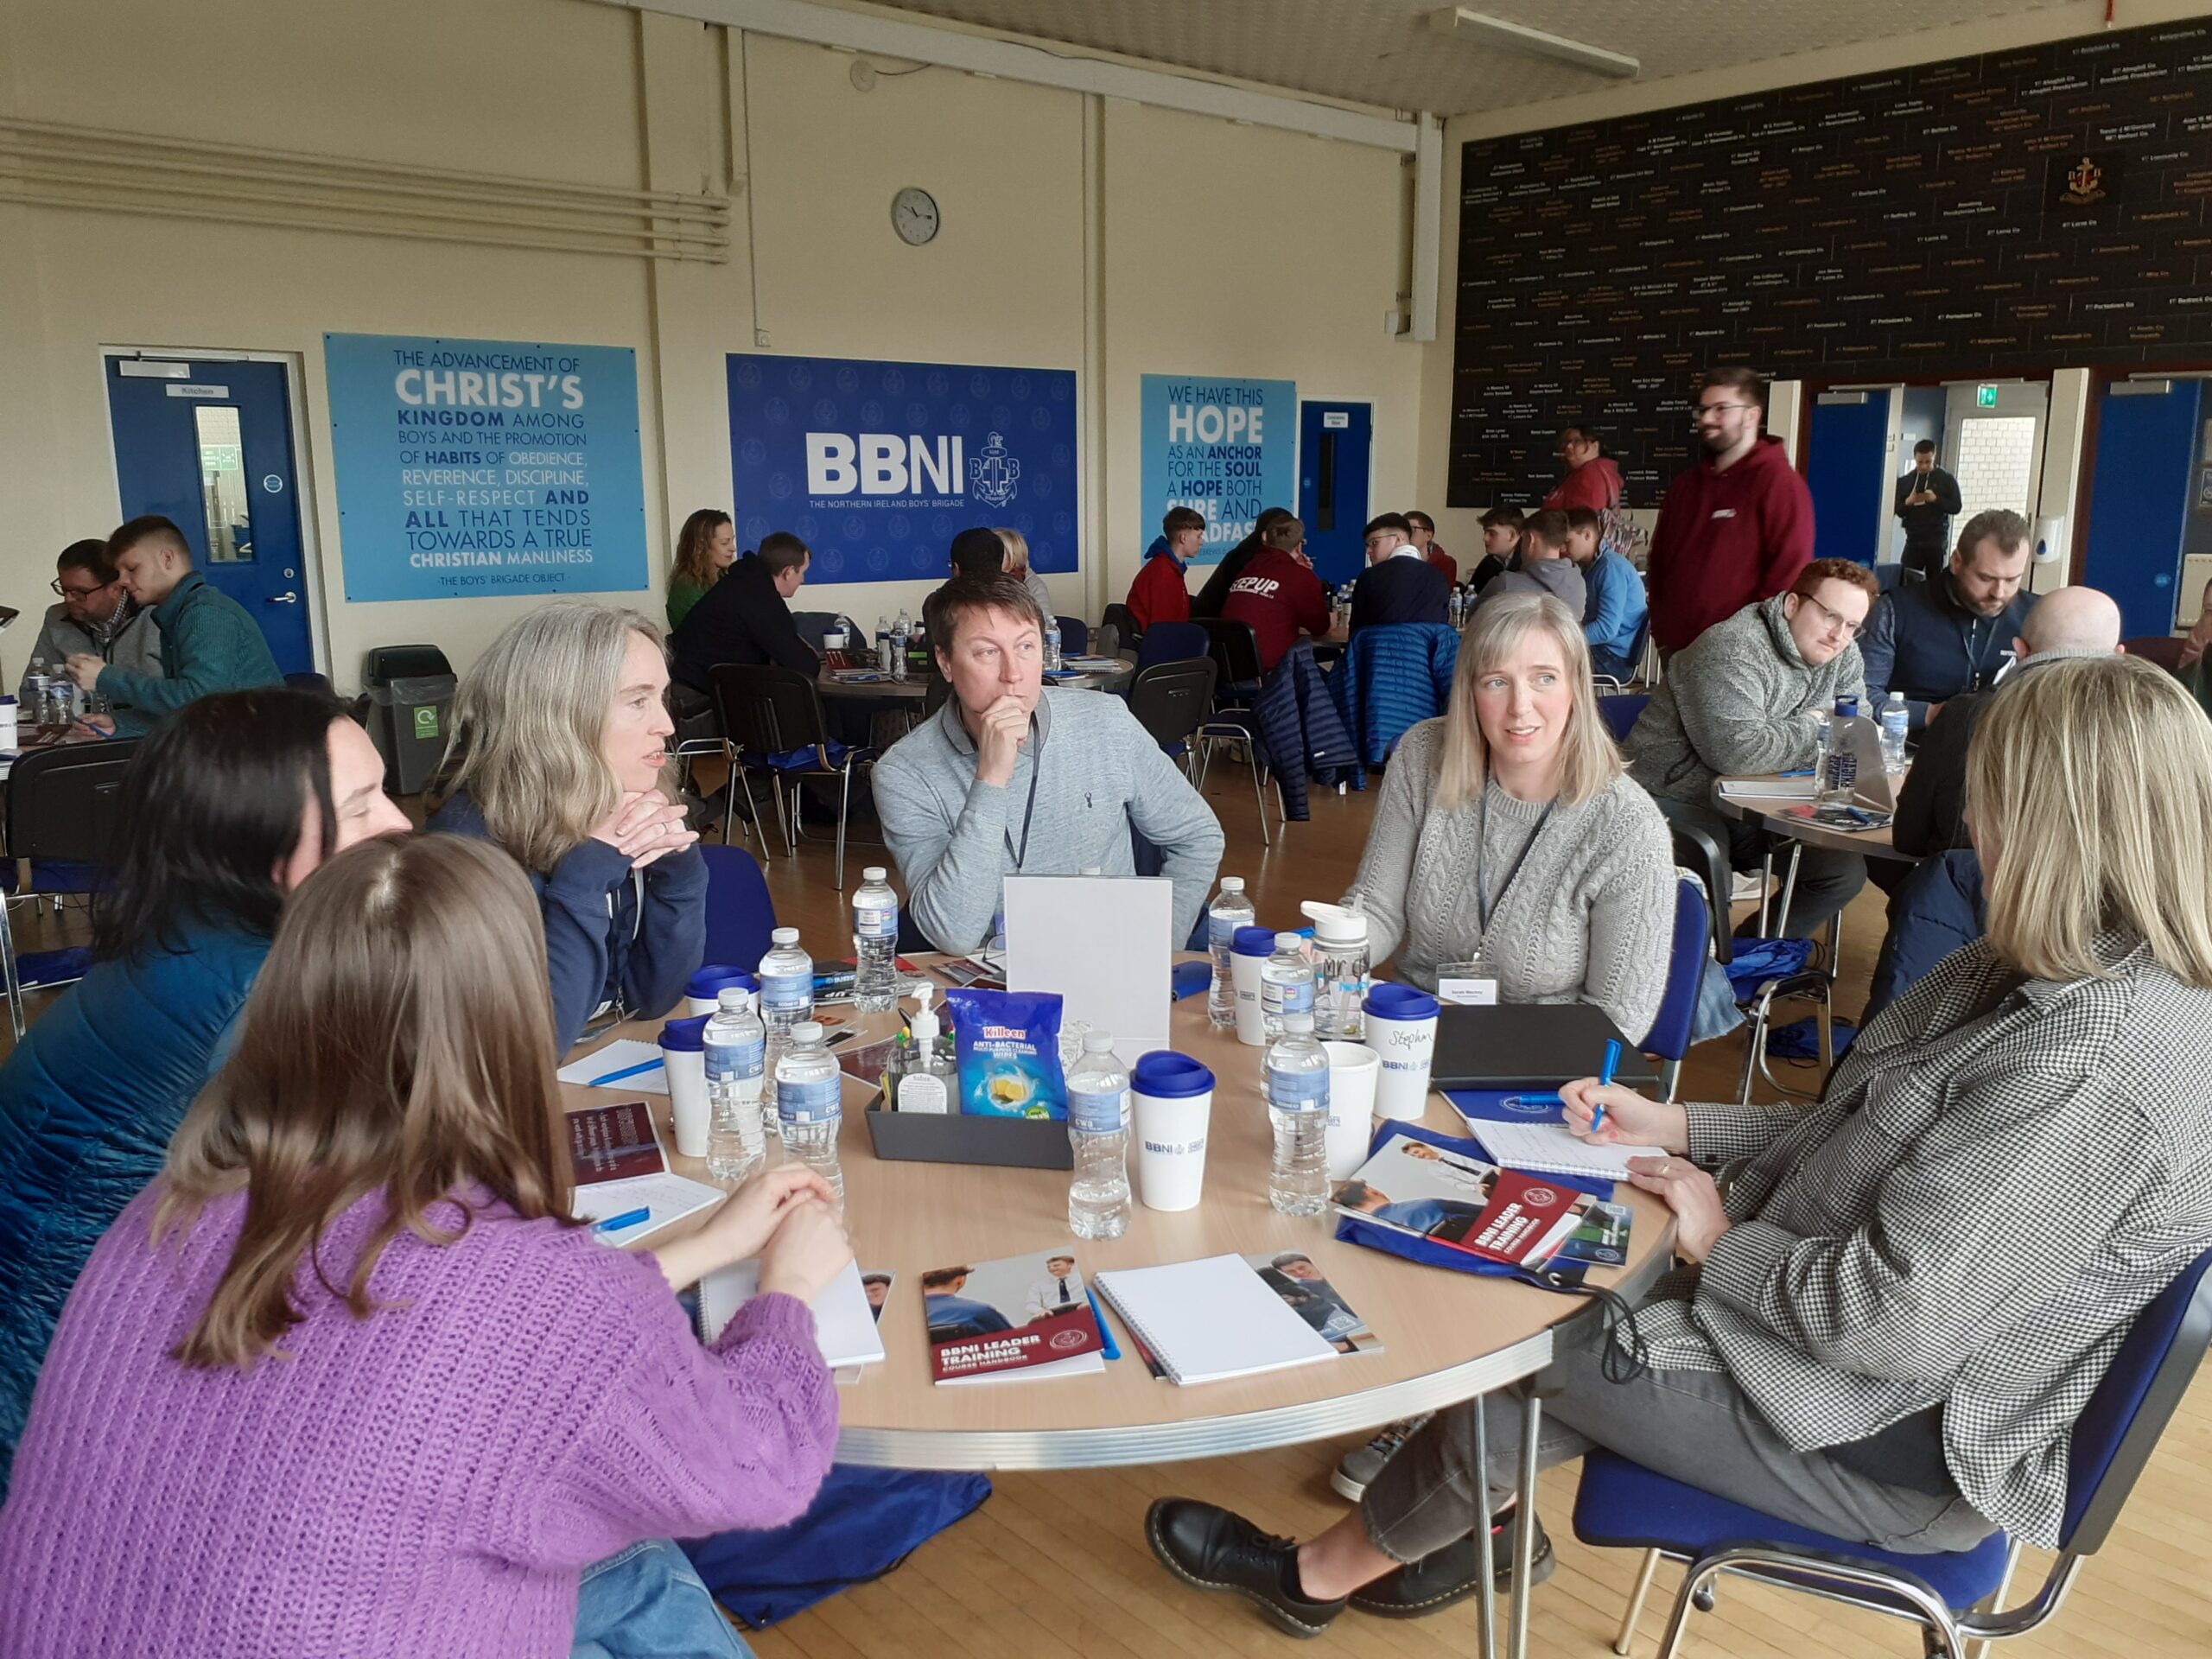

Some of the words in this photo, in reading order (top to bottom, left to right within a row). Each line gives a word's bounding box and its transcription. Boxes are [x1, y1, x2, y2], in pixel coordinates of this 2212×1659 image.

[394, 350, 424, 366] THE
[430, 352, 554, 372] ADVANCEMENT
[559, 357, 580, 372] OF
[181, 386, 214, 396] Kitchen
[395, 368, 584, 410] CHRIST'S
[1168, 385, 1192, 403] WE
[1196, 386, 1230, 404] HAVE
[1235, 388, 1263, 405] THIS
[397, 410, 505, 427] KINGDOM
[512, 413, 584, 429] AMONG
[1169, 404, 1263, 443] HOPE
[398, 430, 436, 444] BOYS
[441, 430, 473, 445] AND
[477, 431, 501, 445] THE
[505, 432, 587, 446] PROMOTION
[400, 450, 419, 464] OF
[425, 451, 481, 464] HABITS
[486, 451, 505, 464] OF
[509, 451, 588, 467] OBEDIENCE,
[1168, 445, 1183, 459] AS
[1186, 445, 1205, 459] AN
[1207, 446, 1262, 460] ANCHOR
[805, 432, 964, 494] BBNI
[1168, 461, 1194, 477] FOR
[1198, 461, 1222, 477] THE
[1225, 461, 1262, 477] SOUL
[403, 469, 501, 487] REVERENCE,
[505, 469, 588, 487] DISCIPLINE,
[403, 489, 536, 506] SELF-RESPECT
[545, 489, 589, 505] AND
[1166, 481, 1176, 496] A
[1181, 480, 1223, 497] HOPE
[1227, 480, 1262, 496] BOTH
[810, 499, 825, 508] THE
[828, 499, 872, 508] NORTHERN
[874, 499, 907, 508] IRELAND
[932, 499, 964, 508] BRIGADE
[1222, 499, 1262, 519] AND
[405, 510, 448, 528] ALL
[459, 509, 512, 527] THAT
[523, 508, 591, 526] TENDS
[406, 530, 516, 550] TOWARDS
[523, 530, 539, 548] A
[544, 528, 592, 547] TRUE
[410, 551, 502, 568] CHRISTIAN
[507, 550, 594, 565] MANLINESS
[491, 574, 530, 584] BRIGADE
[532, 573, 565, 583] OBJECT
[985, 1027, 1026, 1039] Killeen
[973, 1040, 1036, 1051] ANTI-BACTERIAL
[1382, 1060, 1408, 1070] BBNI
[1145, 1141, 1173, 1153] BBNI
[1474, 1225, 1499, 1247] BBNI
[1491, 1203, 1523, 1230] LEADER
[1489, 1216, 1529, 1251] TRAINING
[941, 1343, 979, 1357] BBNI
[983, 1335, 1041, 1351] LEADER
[941, 1347, 1021, 1366] TRAINING
[942, 1362, 977, 1372] COURSE
[979, 1354, 1027, 1366] HANDBOOK
